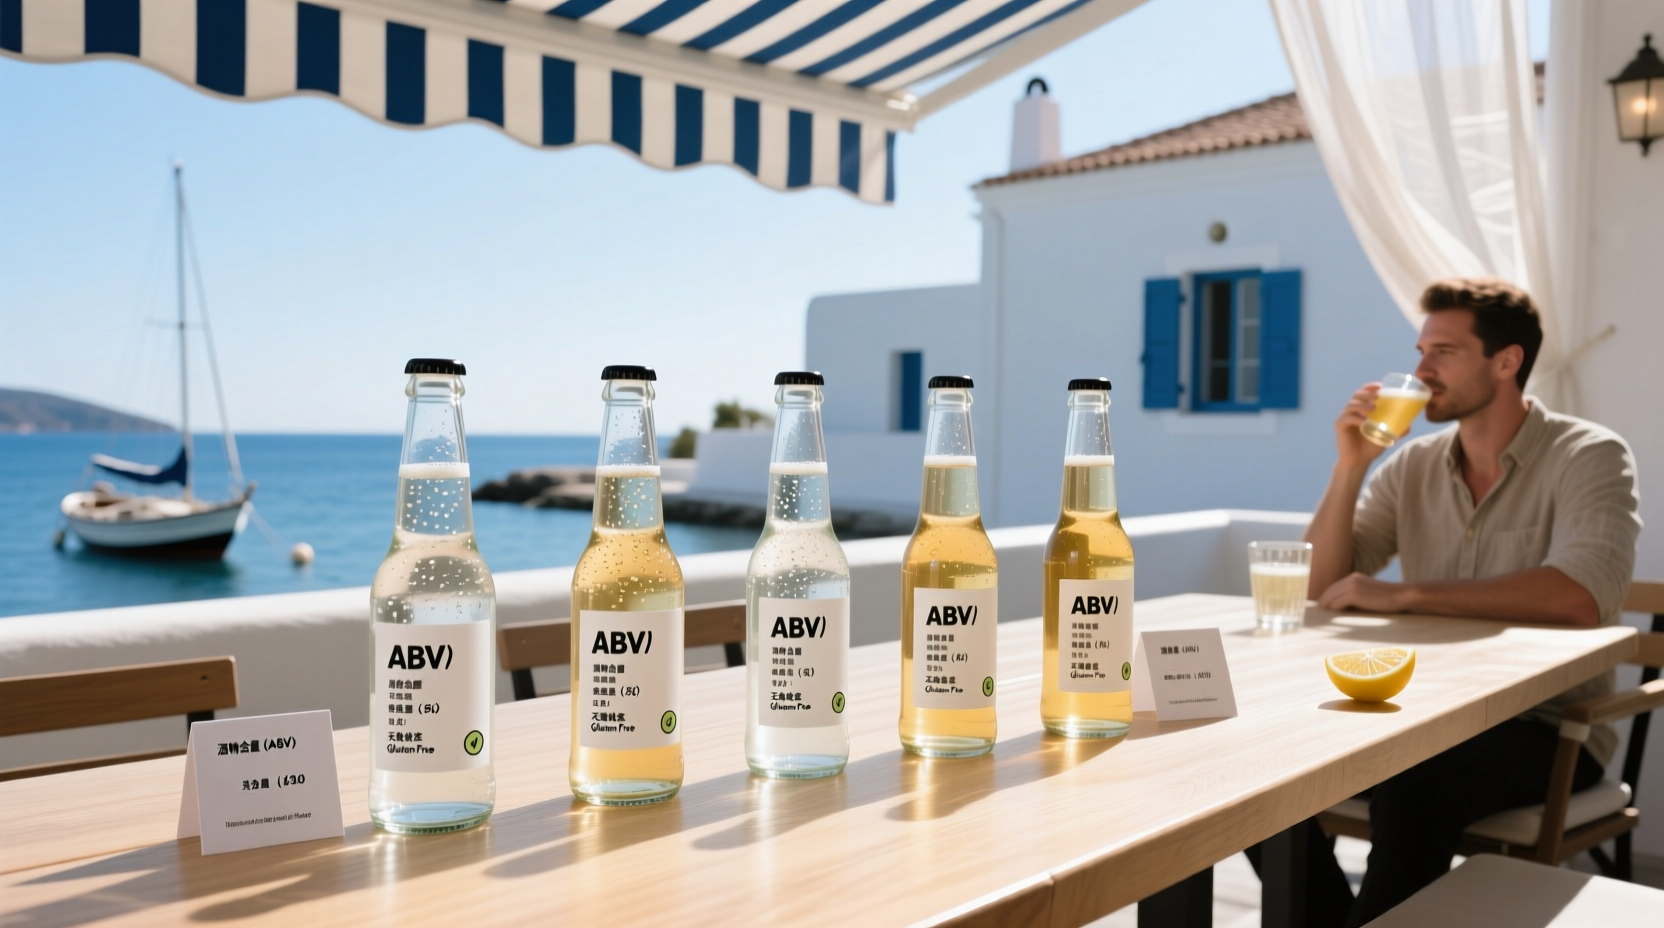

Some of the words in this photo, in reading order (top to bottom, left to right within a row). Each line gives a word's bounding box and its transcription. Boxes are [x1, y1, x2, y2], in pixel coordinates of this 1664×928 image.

[925, 605, 978, 626] ABV)
[1071, 596, 1118, 615] ABV)
[771, 616, 826, 638] ABV)
[592, 631, 652, 654] ABV)
[388, 644, 453, 670] ABV)
